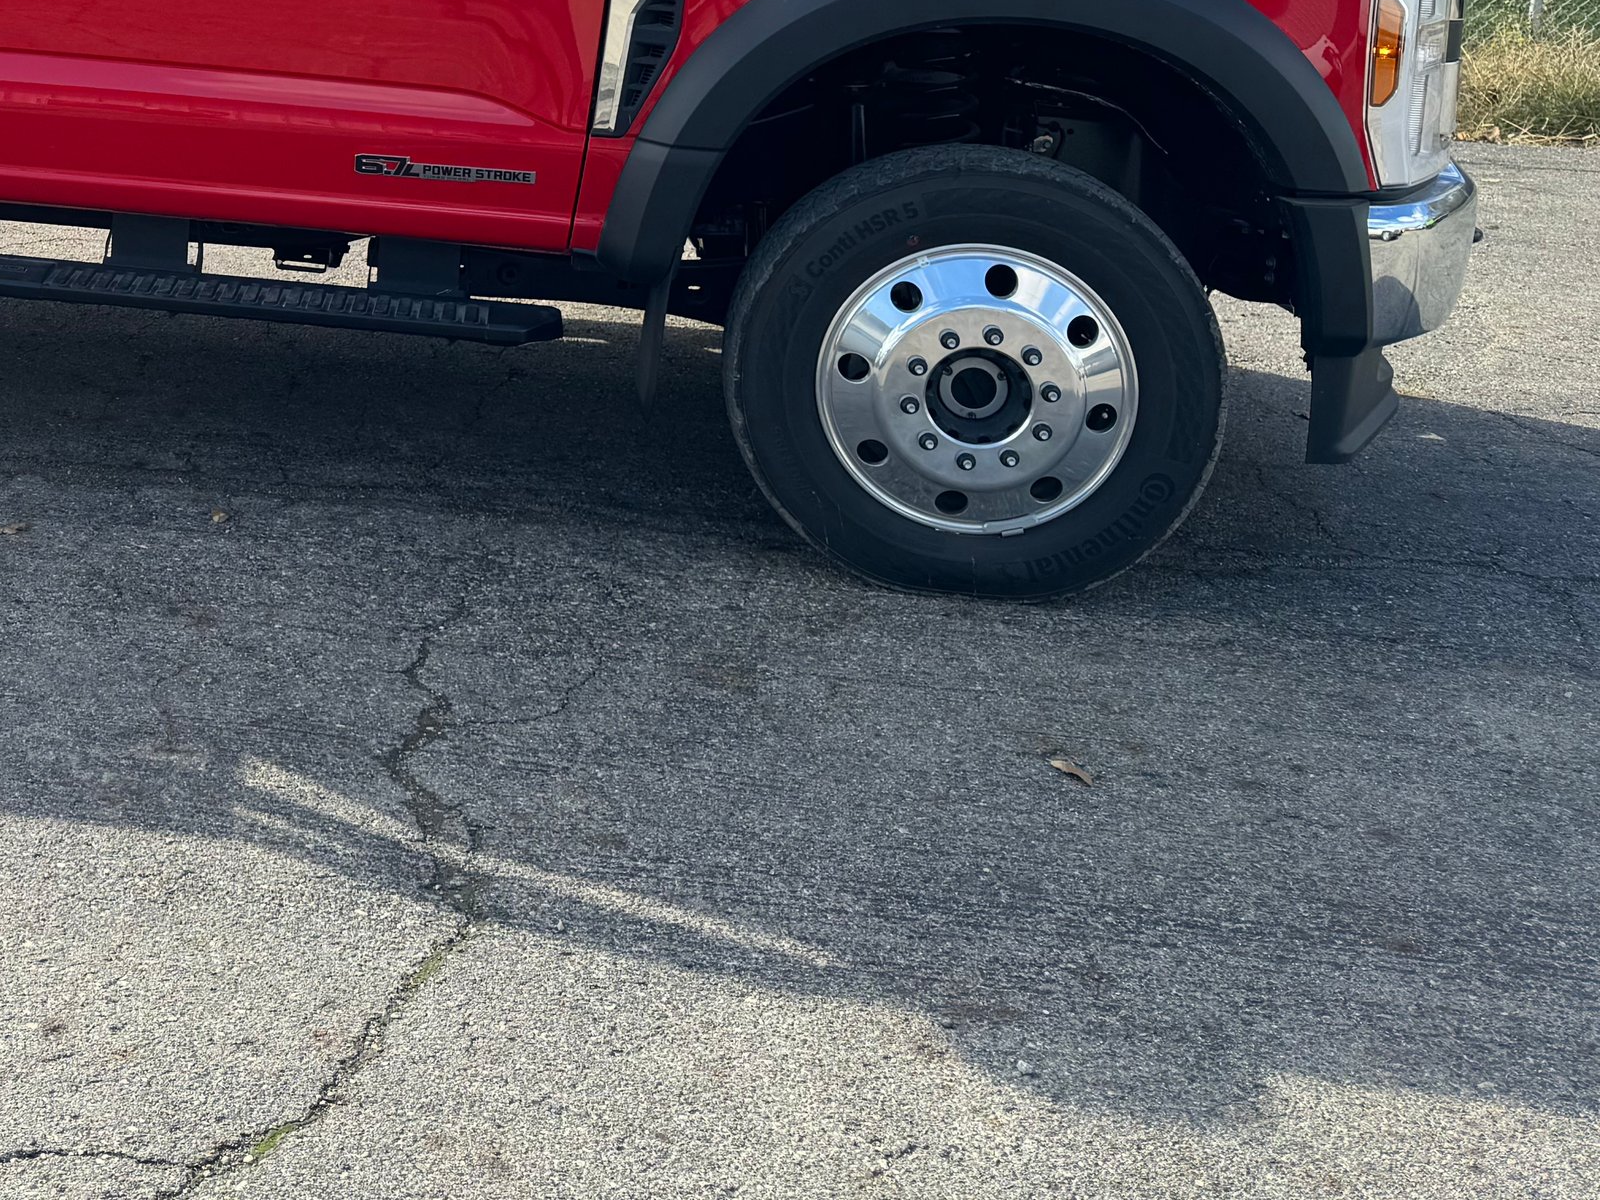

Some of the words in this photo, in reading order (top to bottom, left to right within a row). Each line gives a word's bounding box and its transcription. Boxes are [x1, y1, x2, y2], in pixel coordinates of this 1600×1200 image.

[354, 153, 420, 177] 6.7L
[423, 165, 471, 178] POWER
[475, 169, 531, 182] STROKE
[805, 231, 857, 278] Conti
[854, 208, 903, 241] HSR
[902, 201, 919, 219] 5
[1024, 472, 1176, 582] Continental
